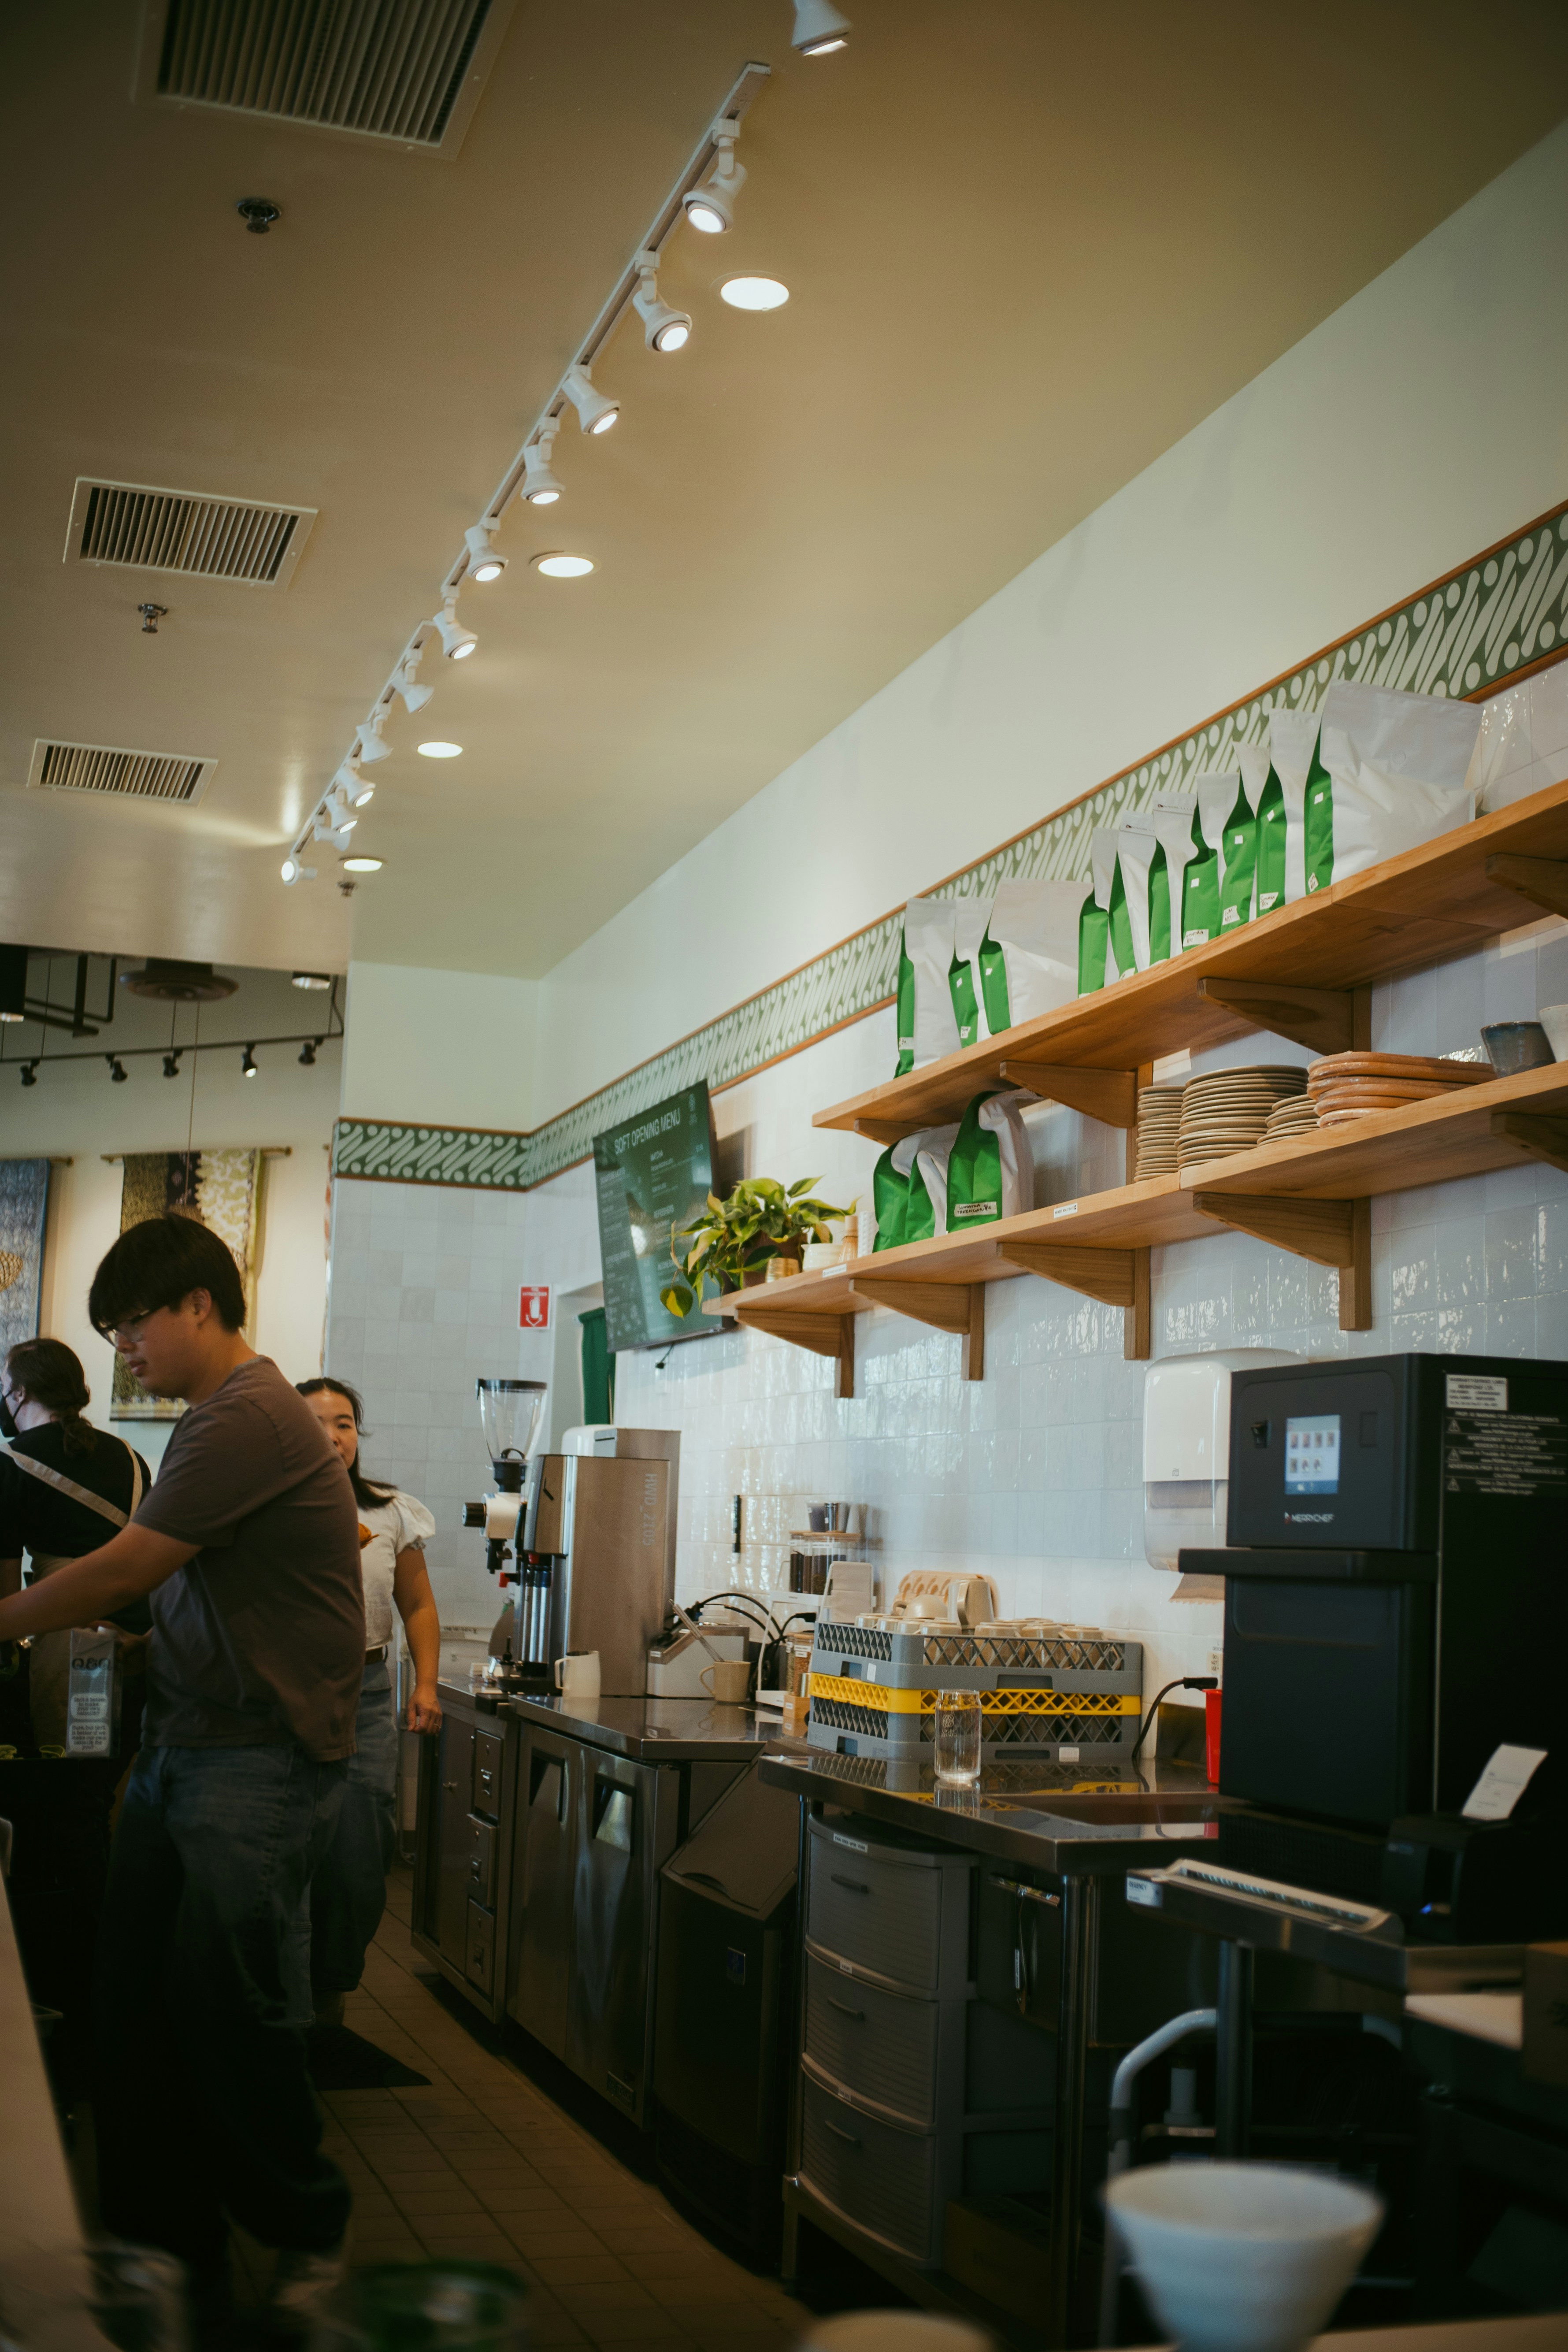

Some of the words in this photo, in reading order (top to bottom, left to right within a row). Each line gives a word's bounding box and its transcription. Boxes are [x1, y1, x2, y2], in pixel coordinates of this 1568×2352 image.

[614, 1132, 630, 1155] SOFT
[631, 1118, 660, 1146] OPENING
[661, 1108, 681, 1132] MENU
[1291, 1513, 1334, 1523] MERRYCHEF
